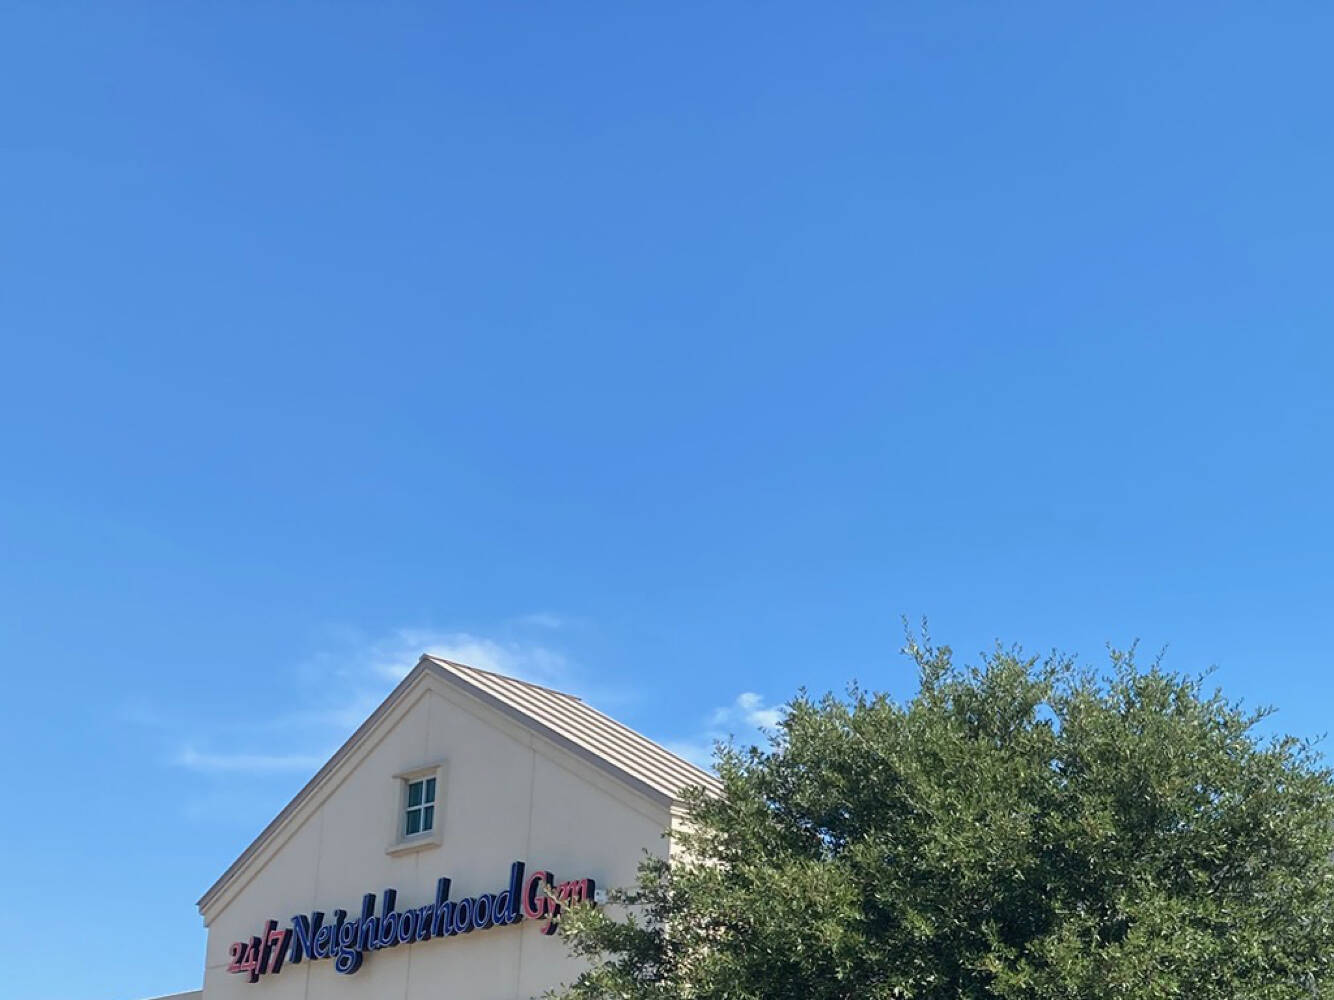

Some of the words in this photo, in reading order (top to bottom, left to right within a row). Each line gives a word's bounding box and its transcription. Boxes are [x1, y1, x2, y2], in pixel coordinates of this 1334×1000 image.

[227, 920, 292, 983] 24/7
[289, 861, 526, 975] Neighborhood
[523, 871, 596, 935] Gym
